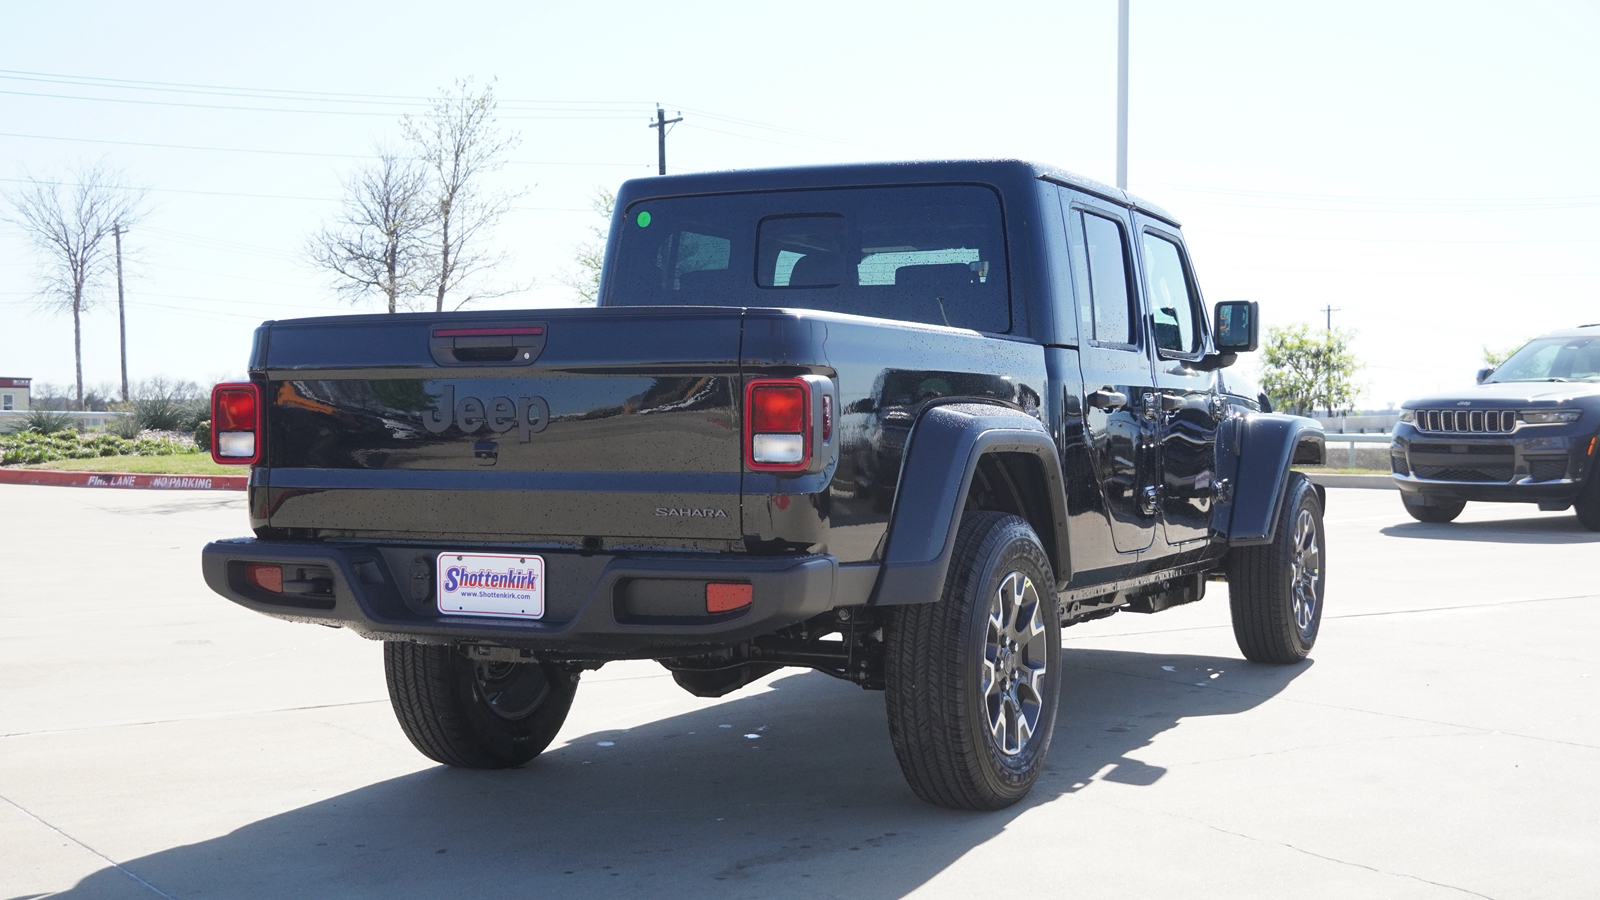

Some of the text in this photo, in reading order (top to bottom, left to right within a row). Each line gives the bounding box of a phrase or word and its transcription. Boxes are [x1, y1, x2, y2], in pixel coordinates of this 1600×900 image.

[422, 384, 550, 444] Jeep
[110, 476, 136, 486] LANE
[153, 477, 212, 489] NO PARKING
[655, 507, 728, 518] SAHARA
[444, 566, 537, 592] Shottenkirk
[461, 591, 531, 600] www.Shottenkirk.com
